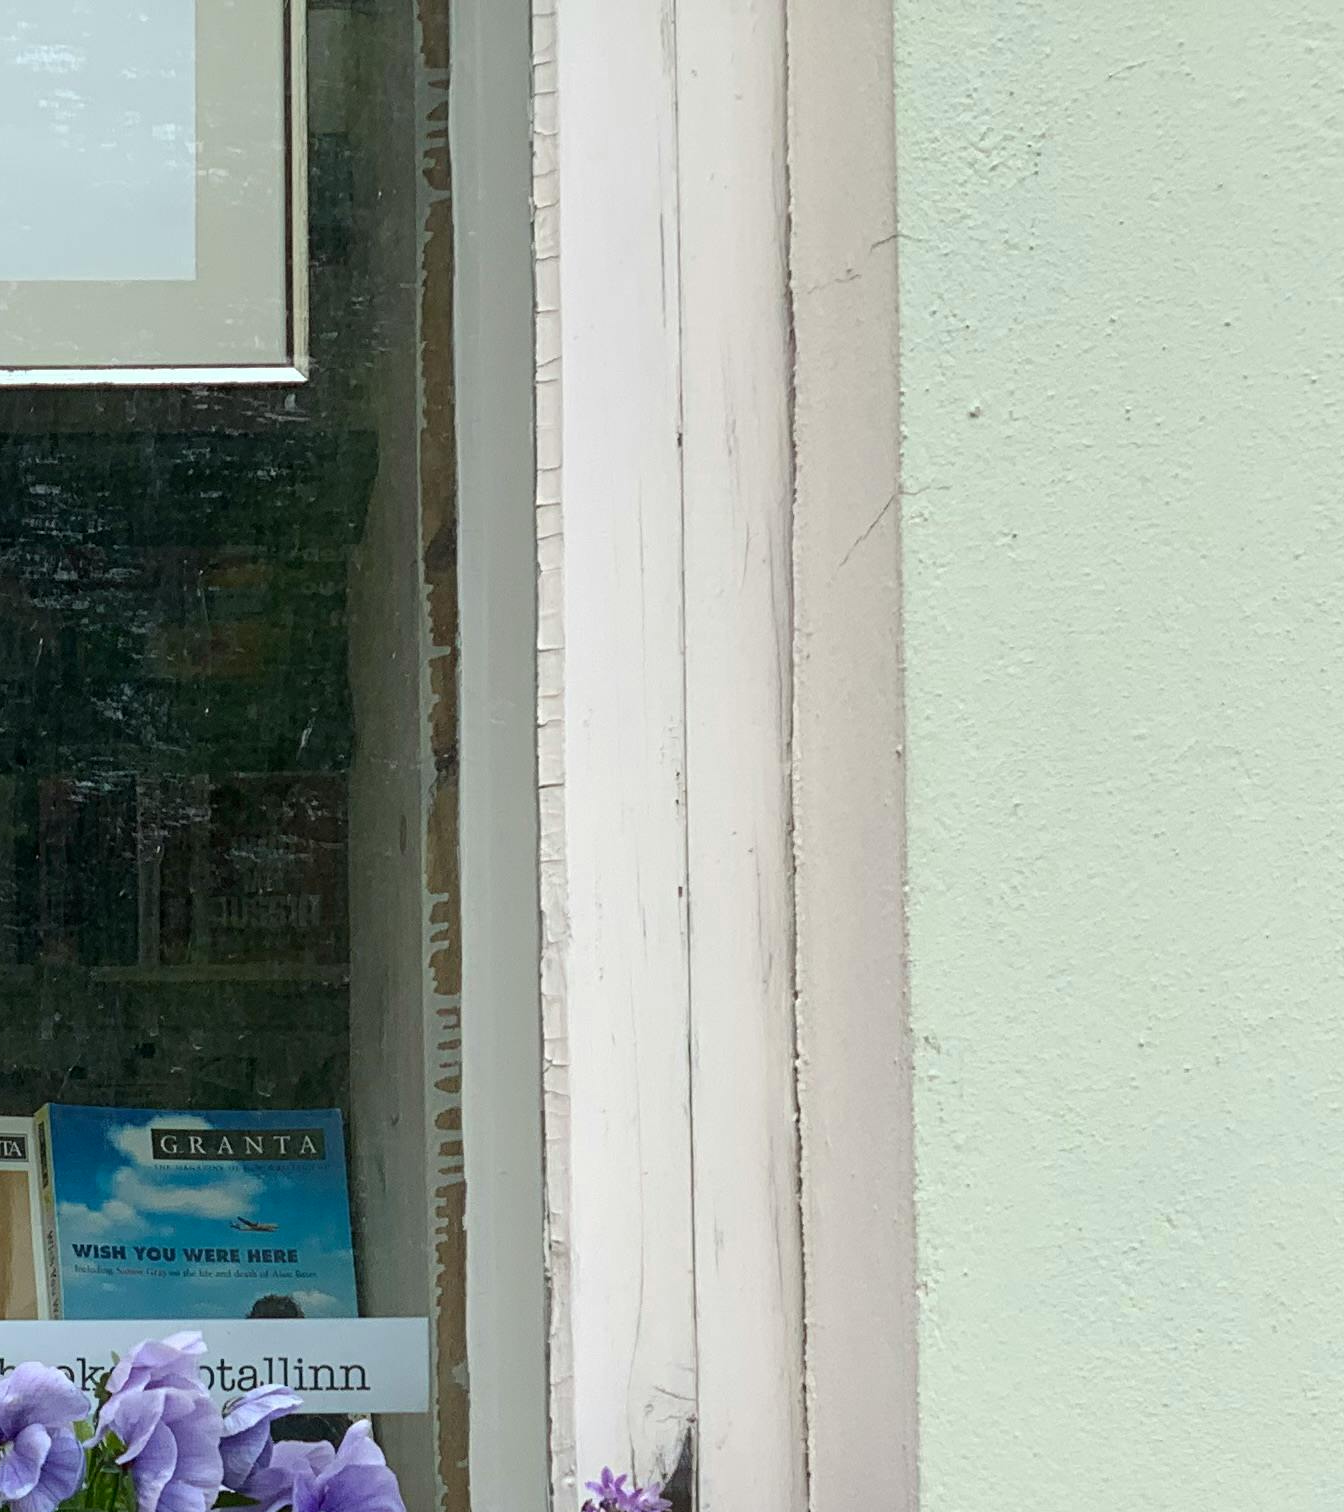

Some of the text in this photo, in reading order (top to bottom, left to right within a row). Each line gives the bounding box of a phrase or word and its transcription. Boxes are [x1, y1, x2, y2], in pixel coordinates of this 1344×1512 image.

[159, 1134, 319, 1156] GRANTA
[72, 1243, 300, 1264] WISH YOU WERE HERE
